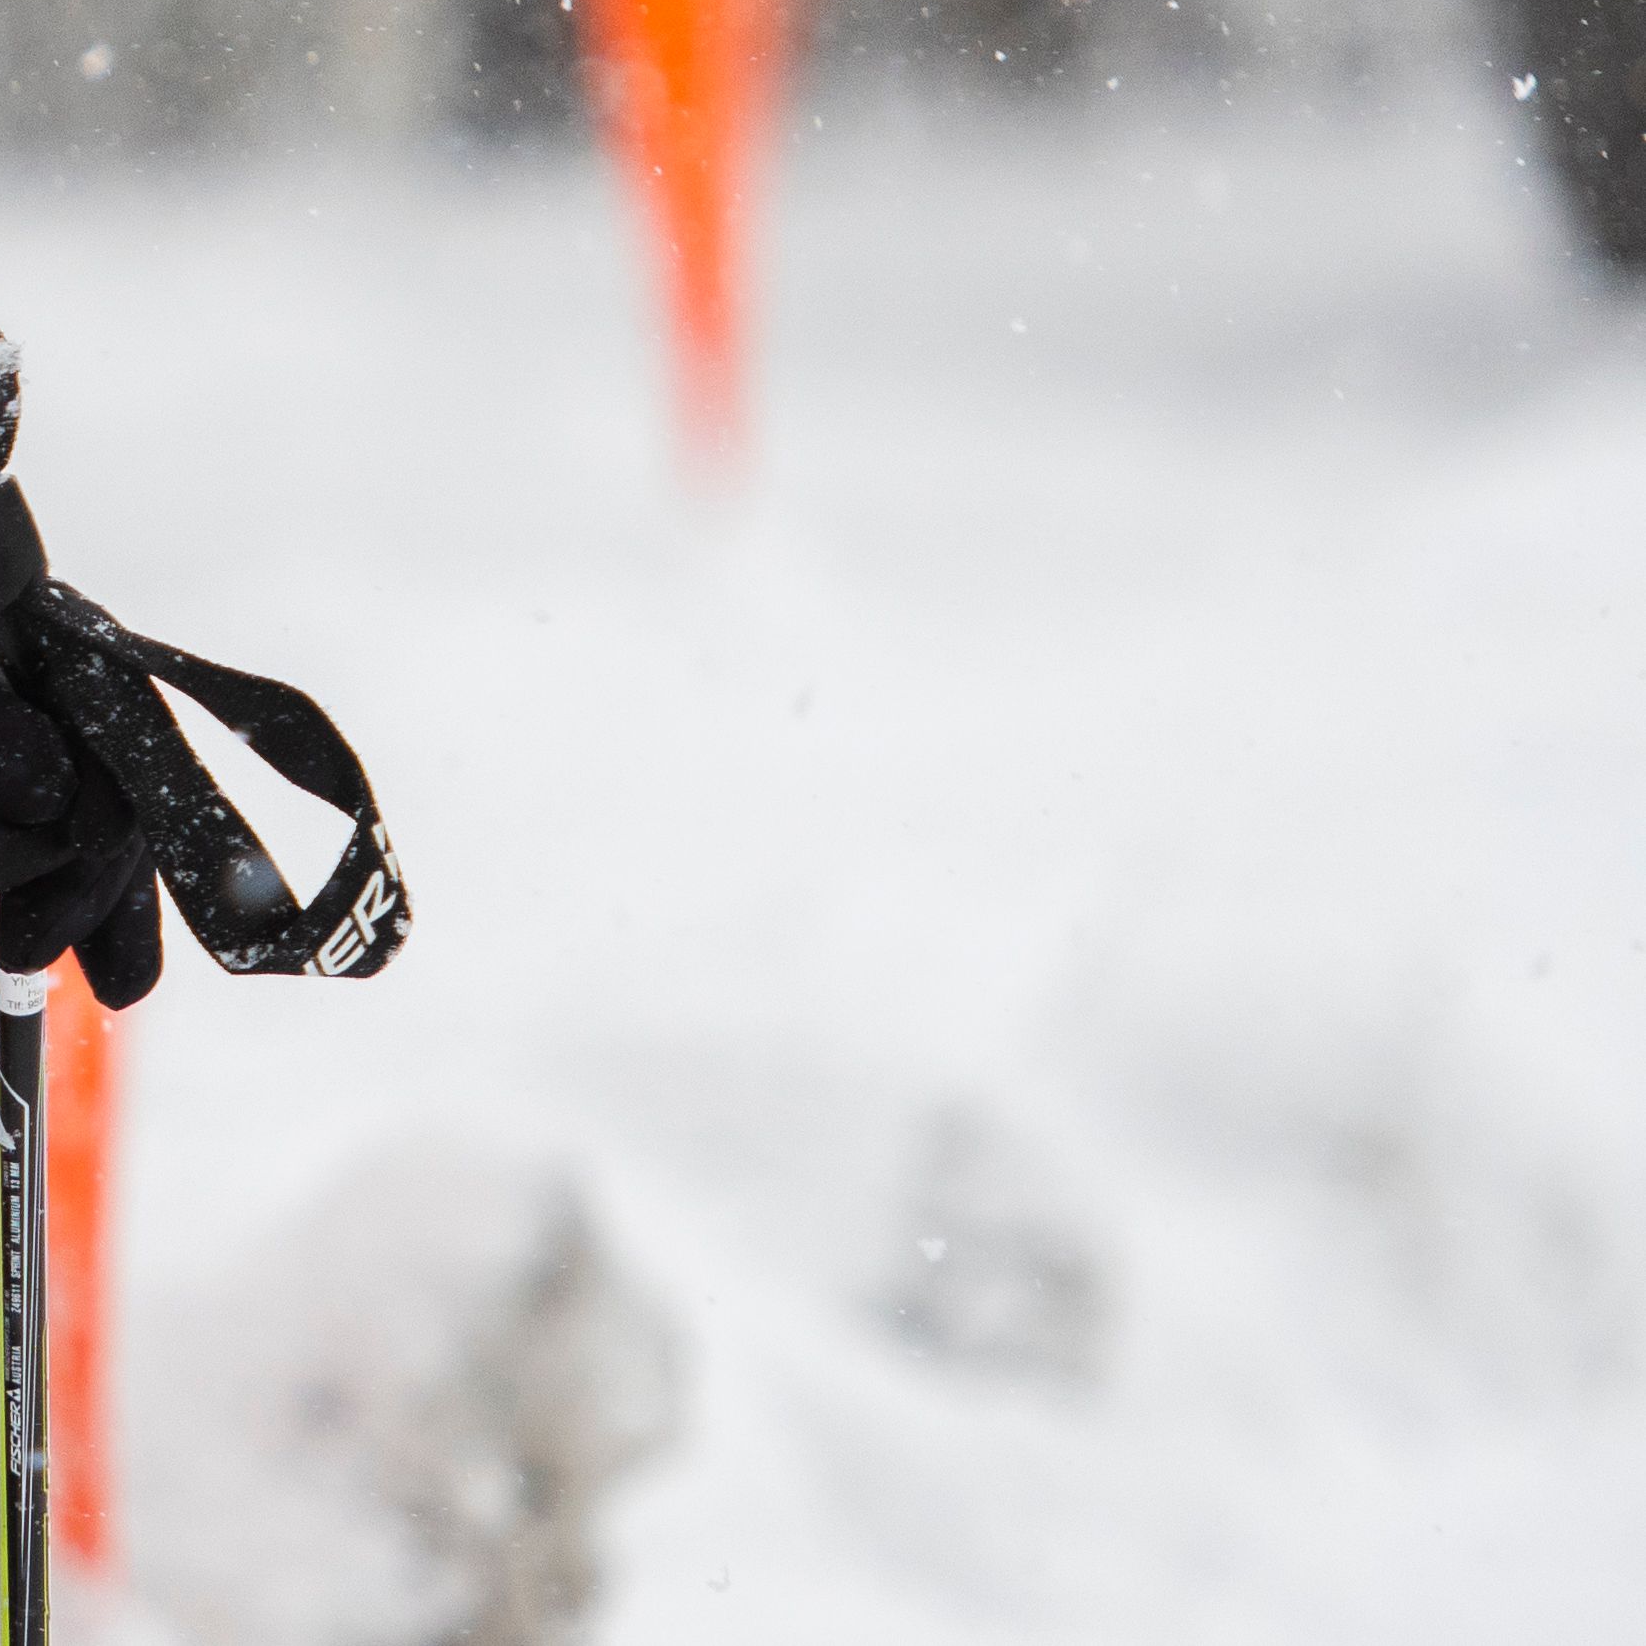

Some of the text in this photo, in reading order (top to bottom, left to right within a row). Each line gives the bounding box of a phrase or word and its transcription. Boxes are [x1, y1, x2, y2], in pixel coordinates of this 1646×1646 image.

[10, 1162, 21, 1177] MM
[10, 1195, 21, 1245] ALUMINIUM
[10, 1250, 22, 1279] SPRINT
[11, 1345, 22, 1384] AUSTRIA
[10, 1400, 22, 1476] FISCHER
